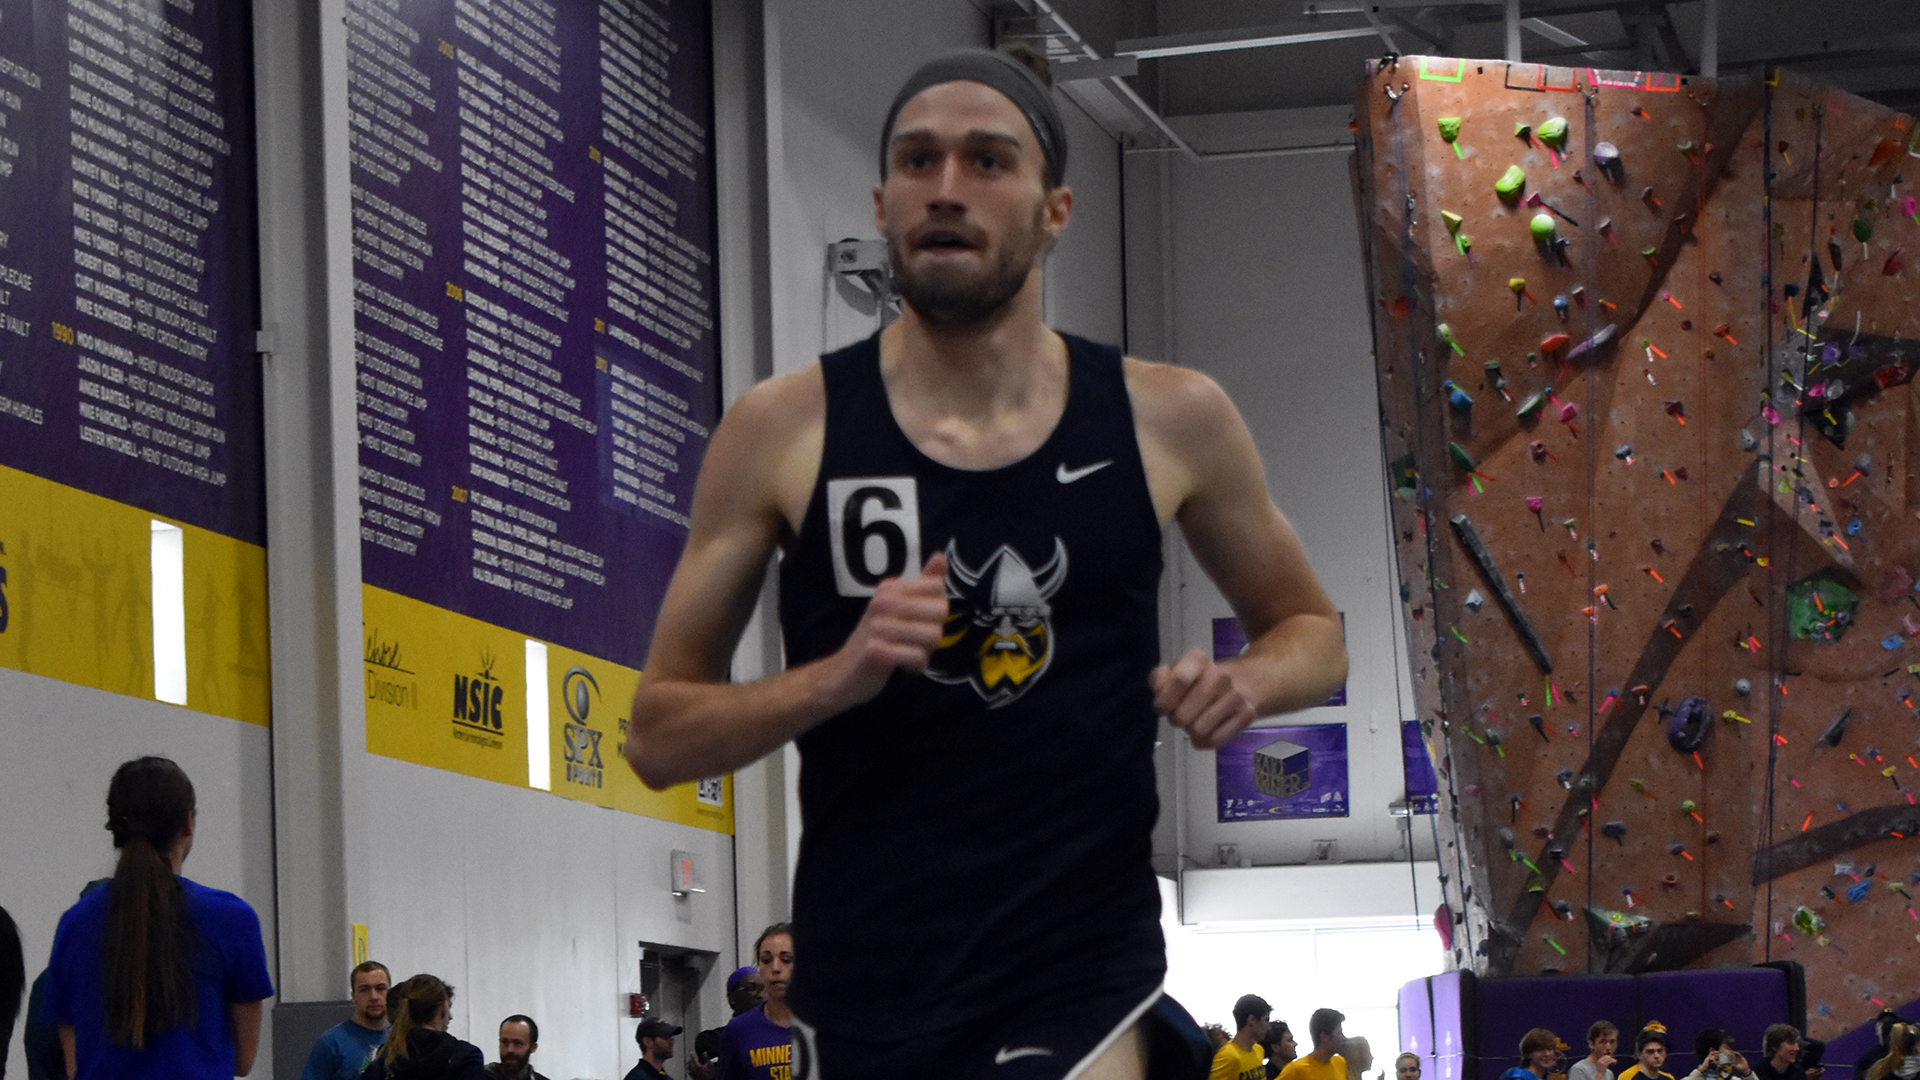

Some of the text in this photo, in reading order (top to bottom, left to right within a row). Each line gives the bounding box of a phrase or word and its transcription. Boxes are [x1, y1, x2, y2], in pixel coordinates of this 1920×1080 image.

[842, 486, 908, 588] 6
[453, 673, 504, 729] NSIC
[563, 722, 604, 770] SPX
